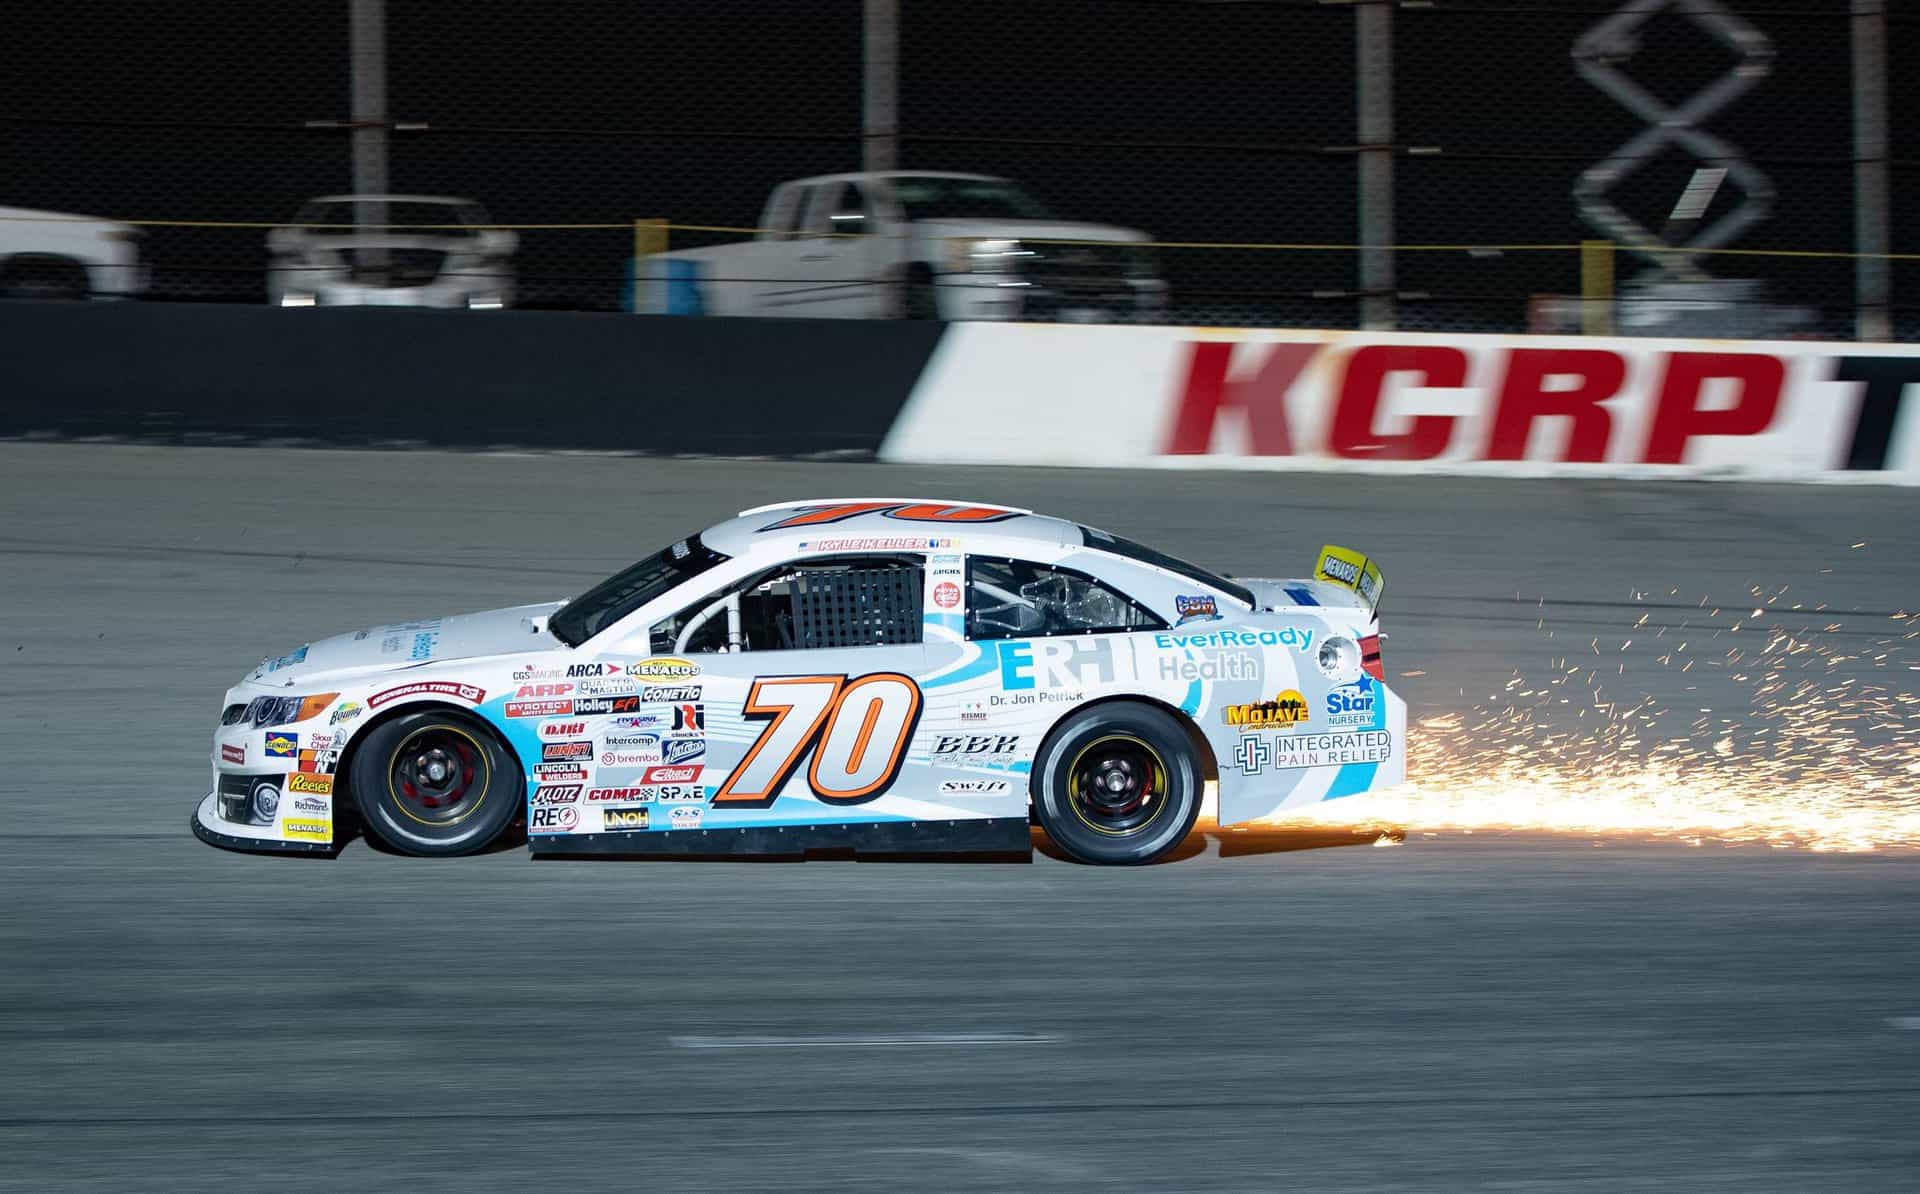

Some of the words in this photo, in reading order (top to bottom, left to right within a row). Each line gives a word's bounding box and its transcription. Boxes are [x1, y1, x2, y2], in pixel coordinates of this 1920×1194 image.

[1160, 341, 1787, 464] KCRP
[816, 539, 862, 551] KYLE
[863, 537, 928, 550] KELLER
[1154, 627, 1313, 650] EverReady
[566, 663, 603, 678] ARCA
[626, 664, 700, 677] MENARDS
[1158, 652, 1258, 681] Health
[515, 683, 575, 698] ARP
[508, 702, 569, 712] PYROTECT
[574, 698, 614, 713] Holley
[990, 694, 1008, 706] Dr.
[1011, 693, 1035, 706] Jon
[1326, 692, 1373, 714] Star
[1224, 705, 1310, 726] MOJAVE
[1328, 714, 1372, 725] NURSERY
[606, 737, 654, 746] Intercomp
[710, 671, 924, 809] 70
[1278, 732, 1389, 753] INTEGRATED
[617, 754, 659, 763] brembo
[1278, 752, 1319, 767] PAIN
[1328, 748, 1390, 764] RELIEF
[535, 763, 579, 773] LINCOLN
[545, 772, 583, 780] WELDERS
[535, 787, 580, 801] KLOTZ
[588, 788, 641, 801] COMP
[604, 809, 648, 825] UNOH
